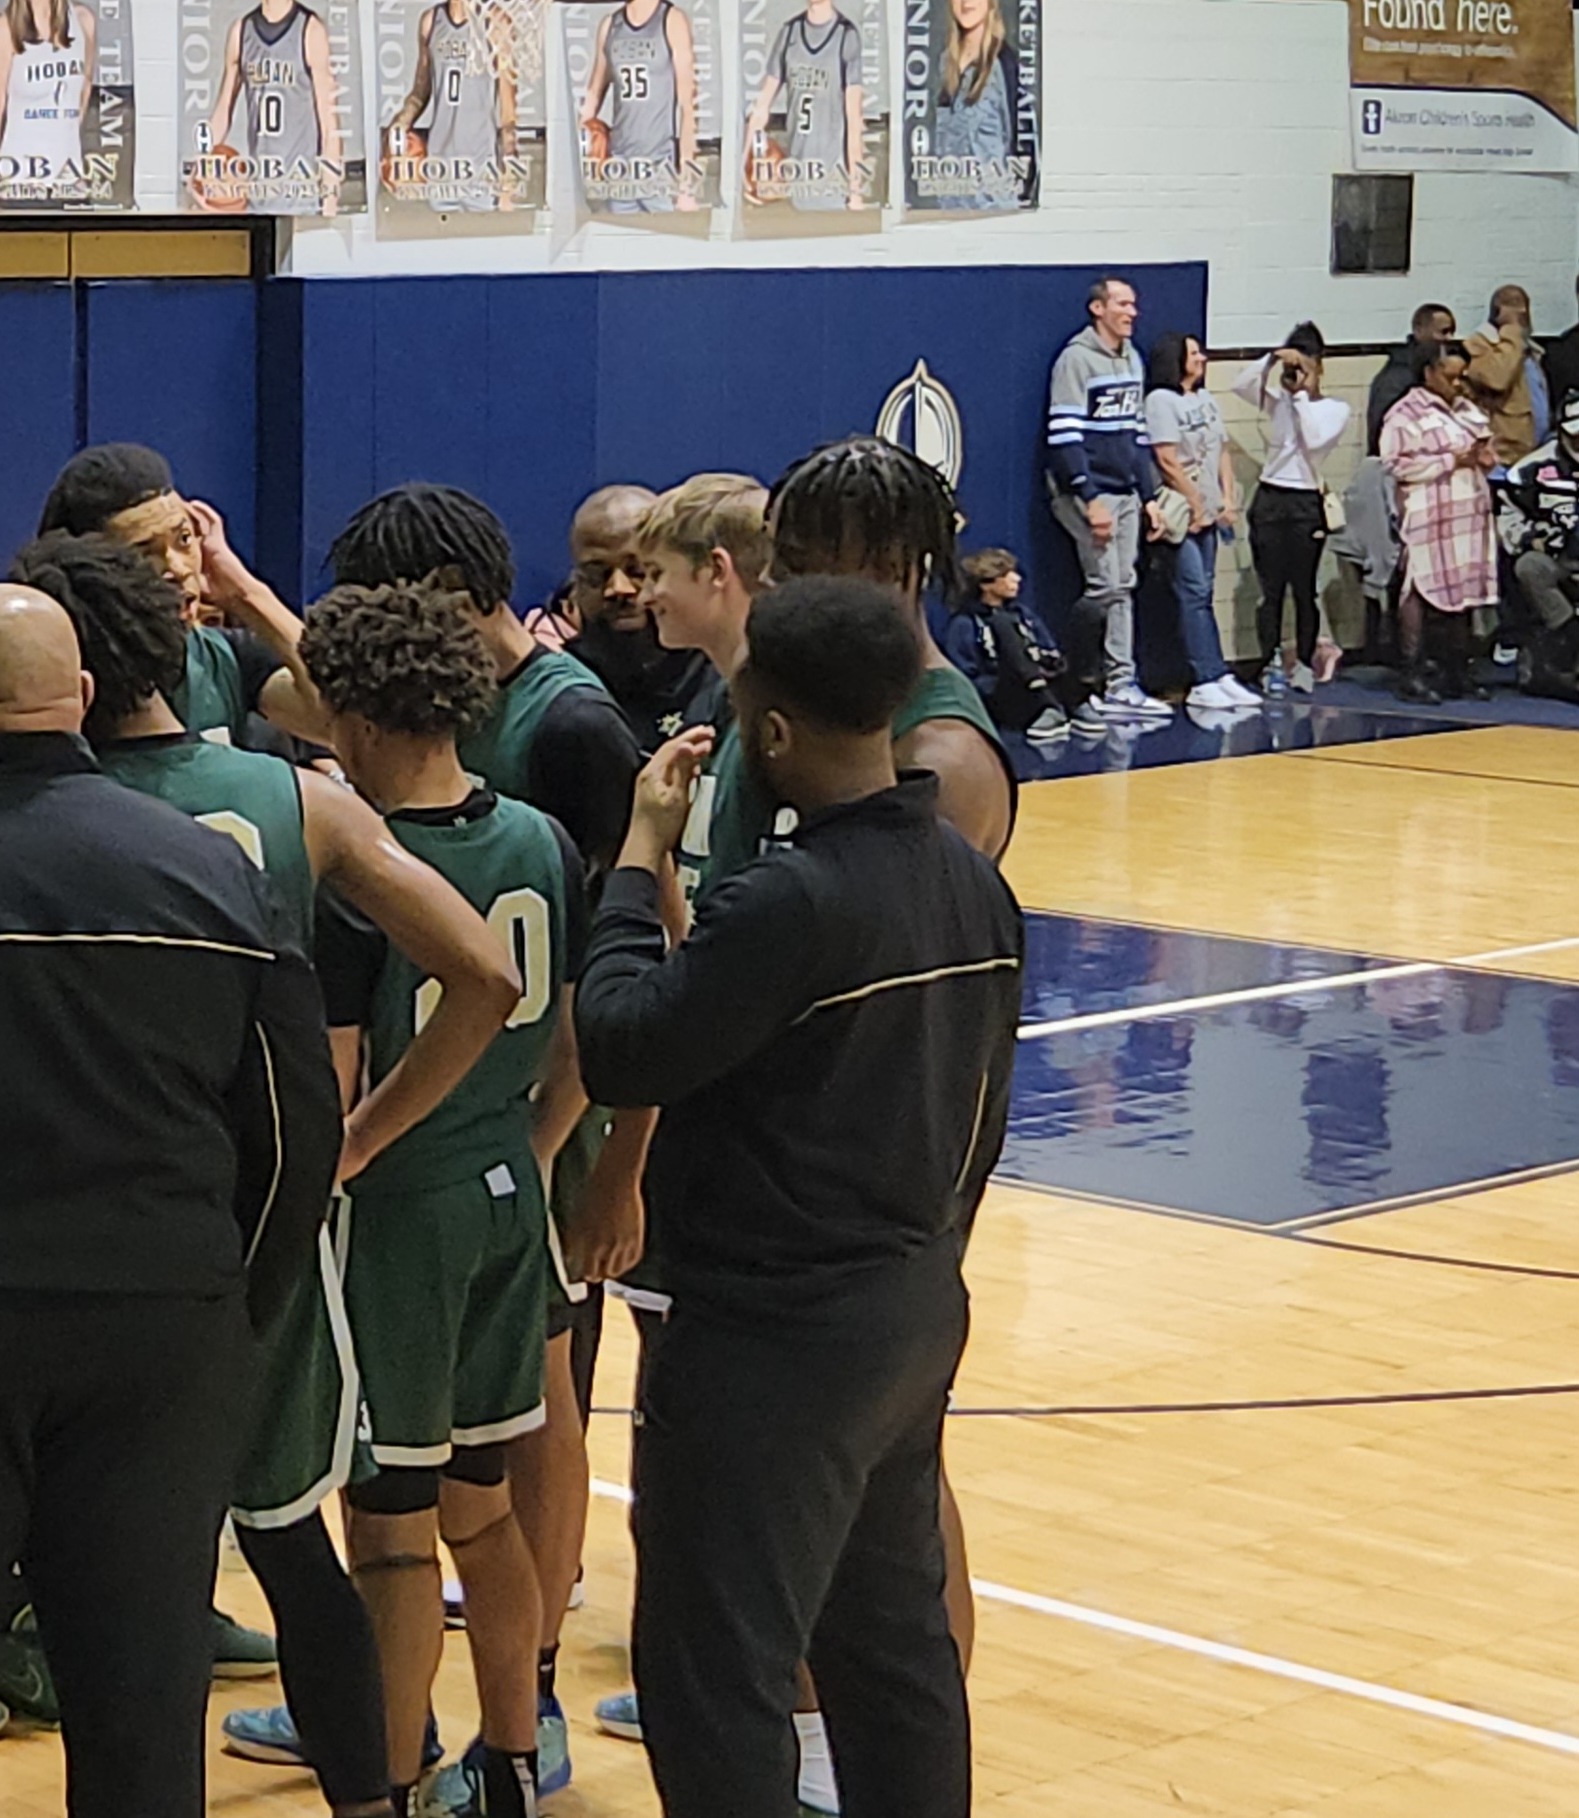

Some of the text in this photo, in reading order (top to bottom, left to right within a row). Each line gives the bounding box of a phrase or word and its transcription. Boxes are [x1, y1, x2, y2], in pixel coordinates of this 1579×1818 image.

[1364, 0, 1518, 34] Found here.
[99, 39, 123, 147] TEAM
[446, 67, 463, 104] 0
[620, 65, 650, 100] 35
[799, 94, 815, 133] 5
[194, 155, 345, 182] HOBAN
[392, 156, 533, 183] HOBAN
[753, 156, 876, 181] HOBAN
[911, 155, 1031, 180] HOBAN
